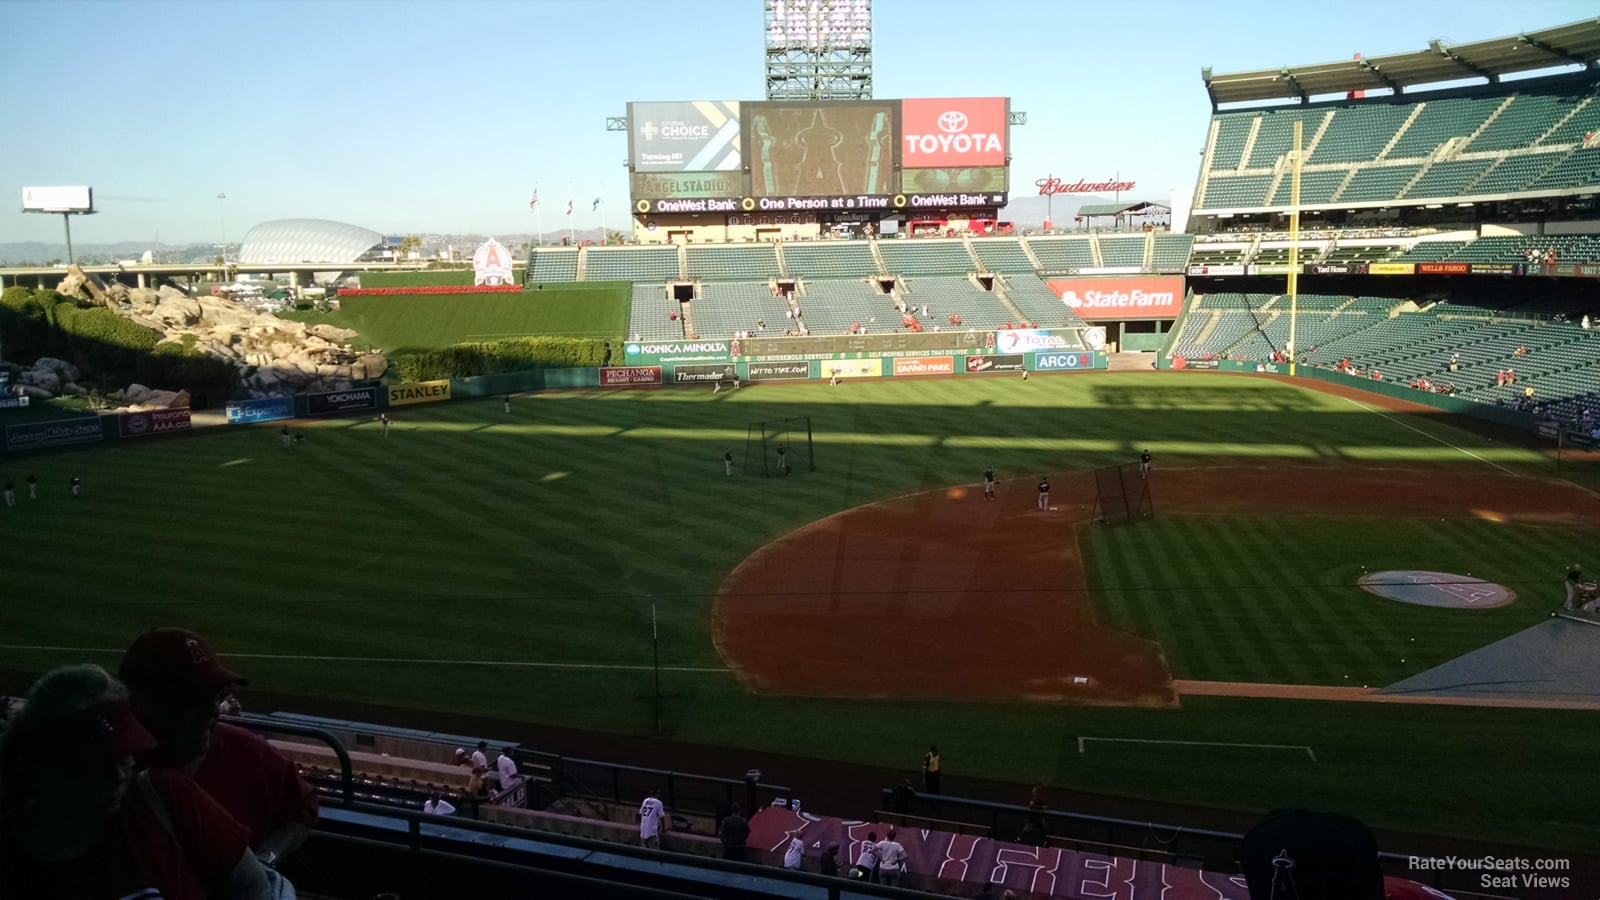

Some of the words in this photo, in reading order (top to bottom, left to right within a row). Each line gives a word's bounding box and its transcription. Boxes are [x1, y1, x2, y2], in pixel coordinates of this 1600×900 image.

[662, 126, 709, 136] CHOICE
[905, 133, 1003, 153] TOYOTA
[1035, 177, 1136, 196] Budweiser
[657, 200, 706, 211] OneWest
[708, 199, 735, 210] Bank
[760, 198, 784, 209] One
[788, 198, 828, 209] Person
[831, 198, 844, 208] at
[847, 199, 854, 208] a
[857, 196, 887, 207] Time
[912, 194, 958, 206] OneWest
[960, 193, 986, 205] Bank
[641, 344, 681, 354] KONICA
[683, 343, 727, 353] MINOLTA
[1039, 355, 1077, 368] ARCO
[606, 369, 655, 377] PECHANGA
[677, 371, 724, 381] Thermador
[326, 391, 371, 403] YOKOHAMA
[391, 384, 448, 401] STANLEY
[245, 404, 289, 417] Experian
[642, 806, 653, 817] 27
